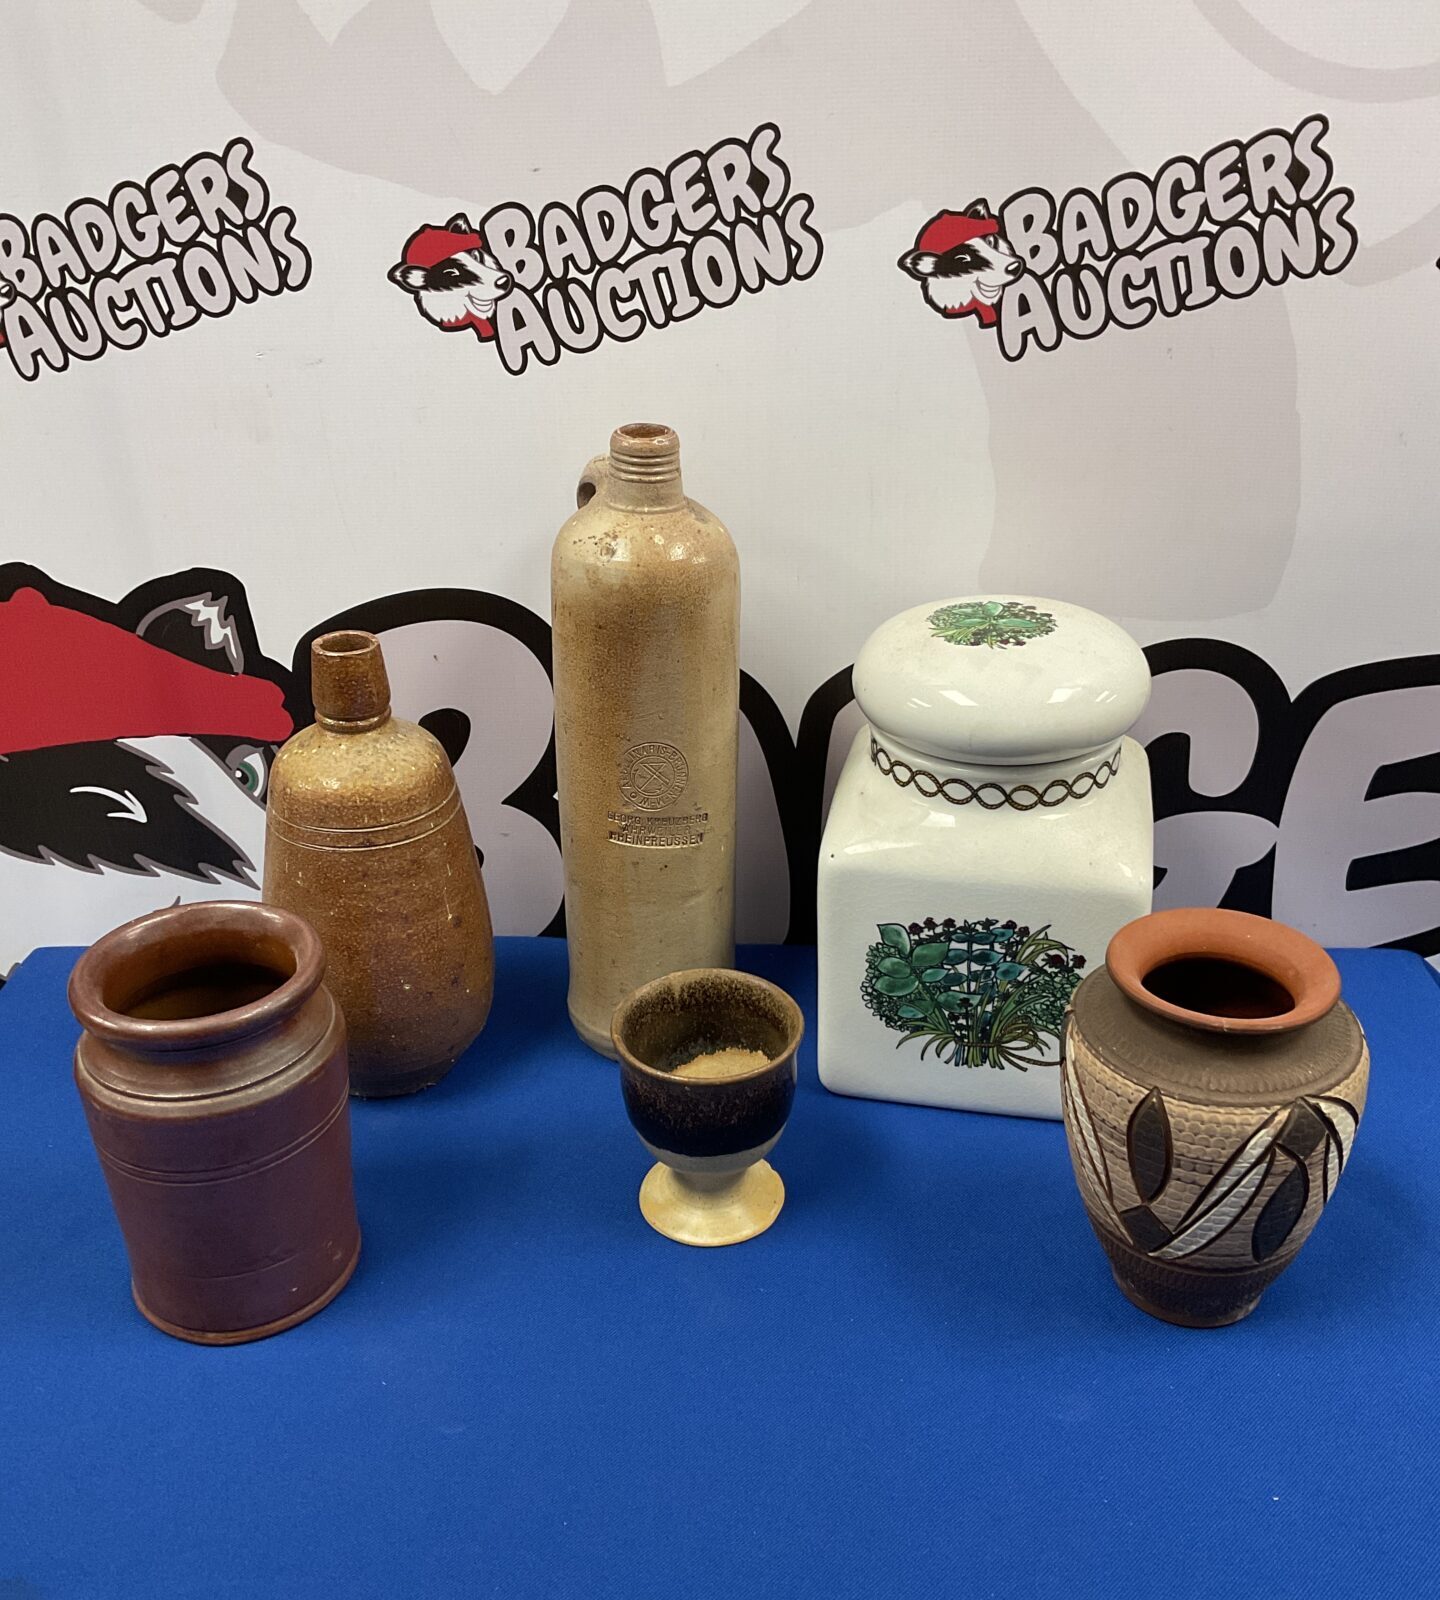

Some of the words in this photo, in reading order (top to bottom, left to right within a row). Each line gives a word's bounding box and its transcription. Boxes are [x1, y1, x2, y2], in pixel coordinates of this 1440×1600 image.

[0, 137, 270, 301] BADGERS
[480, 122, 791, 295] BADGERS
[999, 113, 1332, 277] BADGERS
[999, 187, 1358, 361] AUCTIONS
[0, 206, 312, 382] AUCTIONS
[496, 193, 824, 376] AUCTIONS
[607, 810, 641, 825] GEORG
